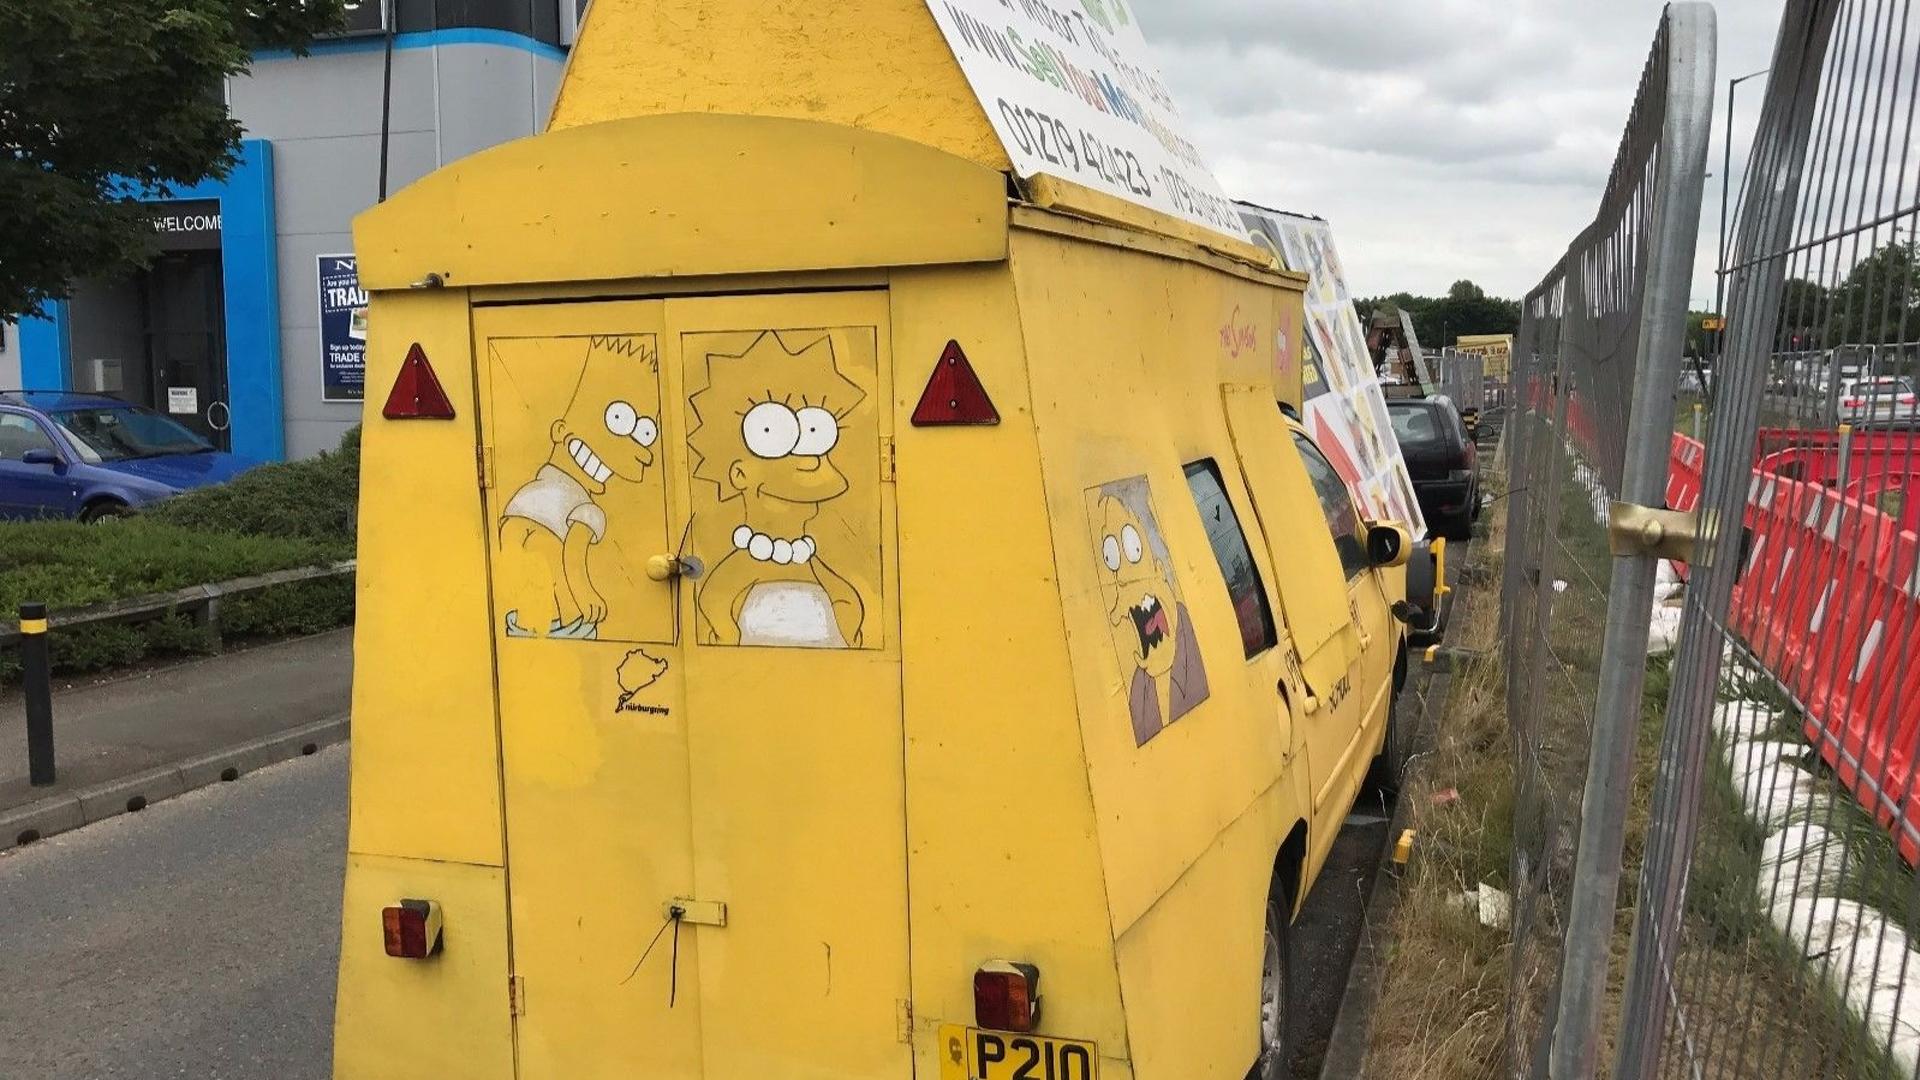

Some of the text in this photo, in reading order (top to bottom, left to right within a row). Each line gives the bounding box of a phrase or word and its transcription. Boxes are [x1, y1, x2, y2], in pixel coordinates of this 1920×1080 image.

[997, 97, 1080, 173] 01279
[1078, 128, 1152, 198] 421423
[329, 352, 360, 363] TRADE
[976, 1033, 1092, 1080] P210
